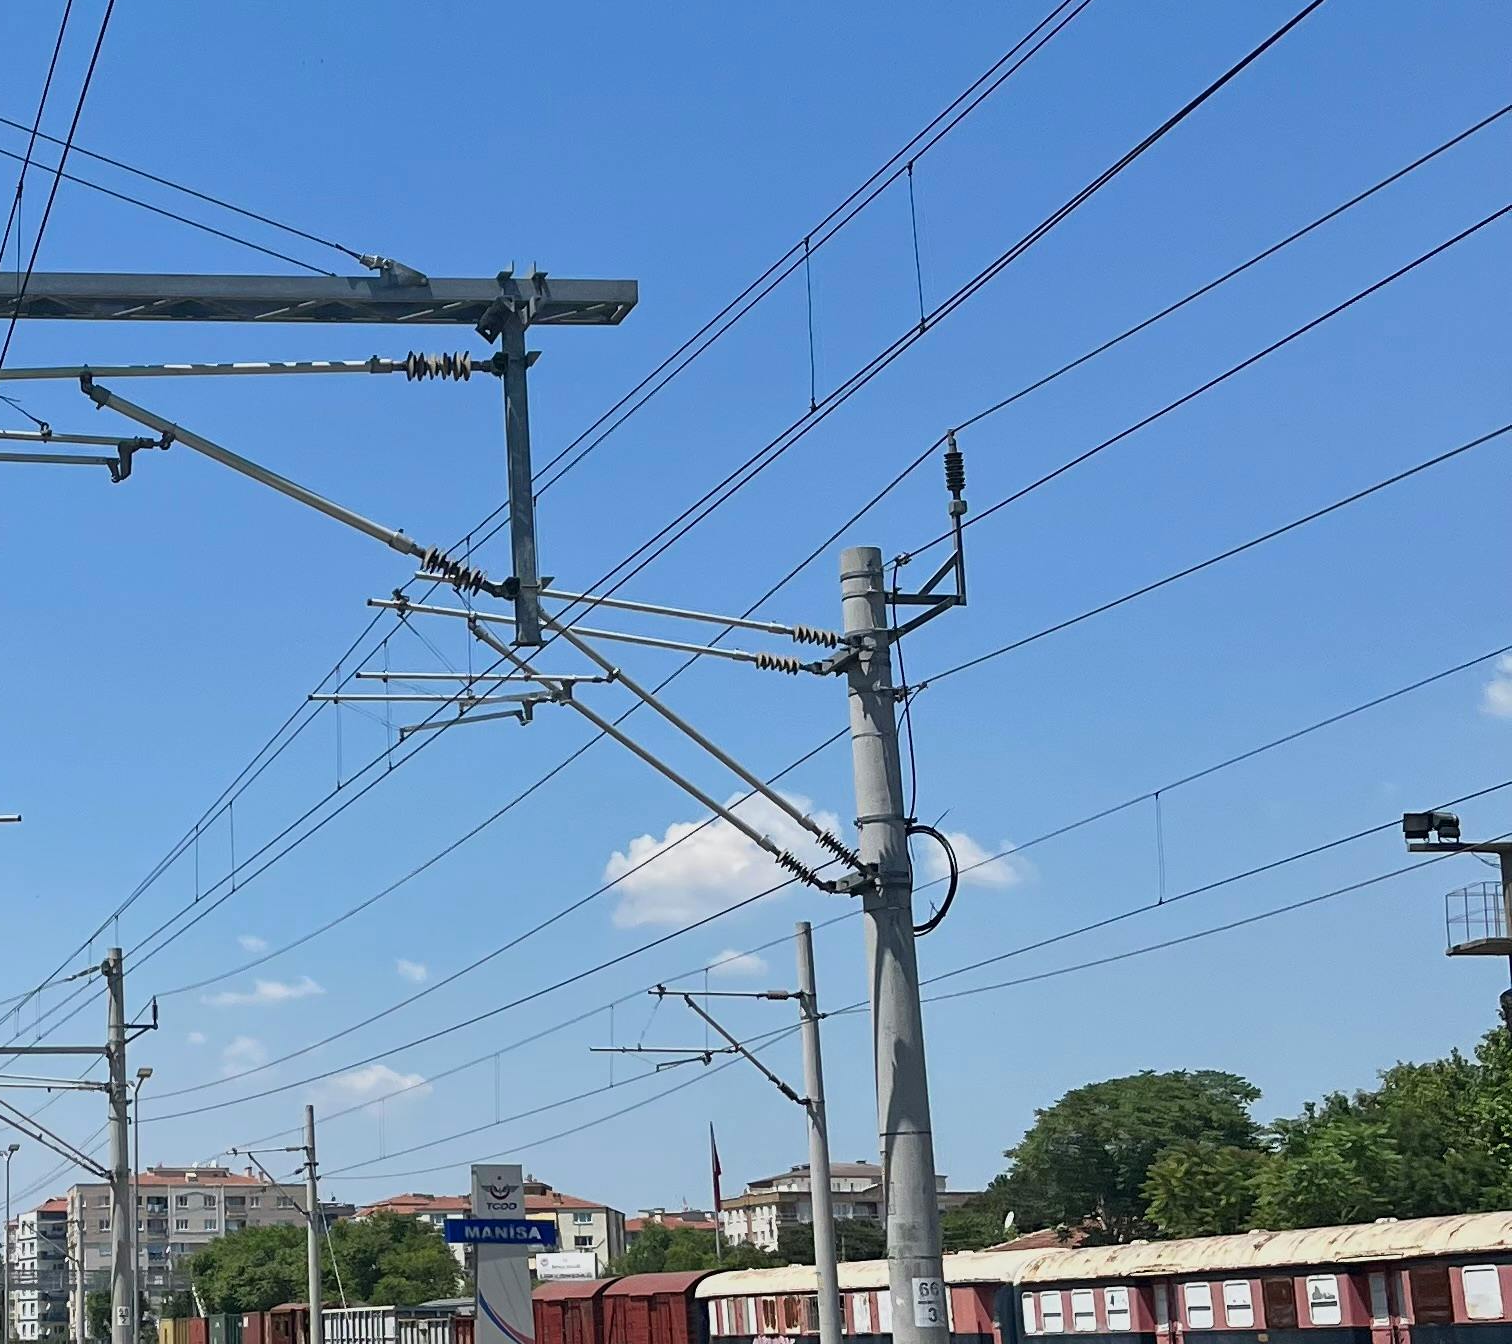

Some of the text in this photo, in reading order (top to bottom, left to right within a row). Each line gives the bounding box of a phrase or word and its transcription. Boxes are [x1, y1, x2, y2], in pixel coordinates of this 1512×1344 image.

[464, 1224, 542, 1240] MANİSA
[919, 1281, 939, 1296] 66
[928, 1307, 938, 1322] 3
